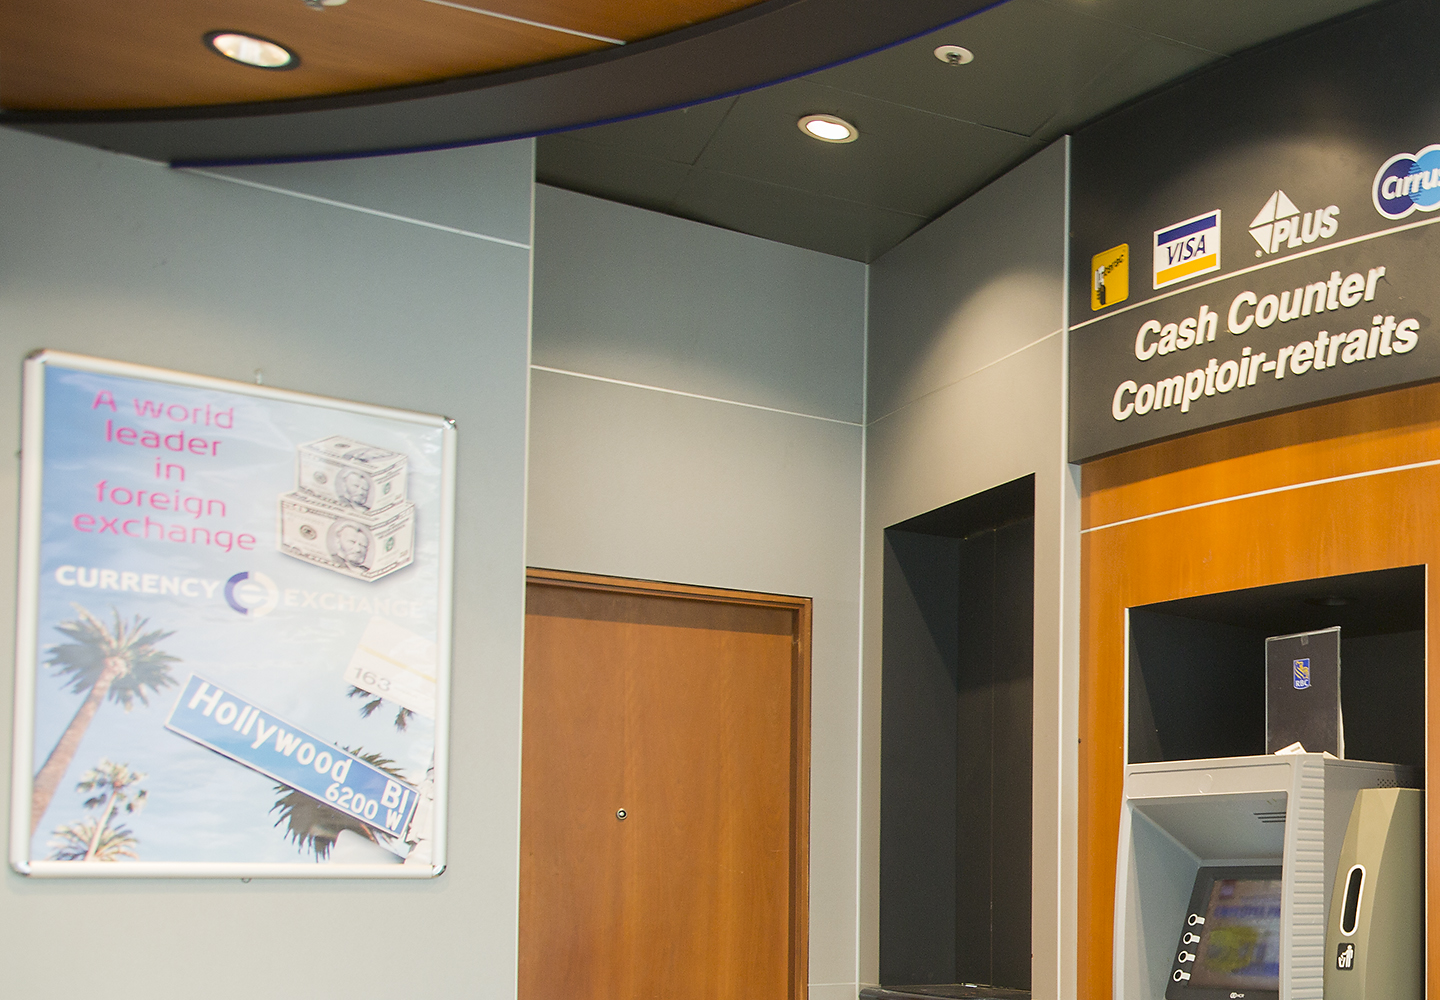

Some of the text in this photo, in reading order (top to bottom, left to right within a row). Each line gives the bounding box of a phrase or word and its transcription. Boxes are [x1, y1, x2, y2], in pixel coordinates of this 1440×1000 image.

[1270, 204, 1340, 254] PLUS
[1165, 234, 1207, 266] VISA
[1135, 266, 1386, 362] Cash Counter
[1111, 315, 1420, 422] Comptoir-retraits
[92, 390, 234, 429] A world
[105, 419, 222, 457] leader
[155, 456, 185, 482] in
[96, 480, 227, 518] foreign
[72, 513, 257, 553] exchange
[55, 565, 221, 600] CURRENCY
[284, 588, 423, 618] EXCHANGE
[354, 667, 391, 692] 163
[188, 681, 352, 784] Hollywood
[325, 782, 403, 831] 6200 W
